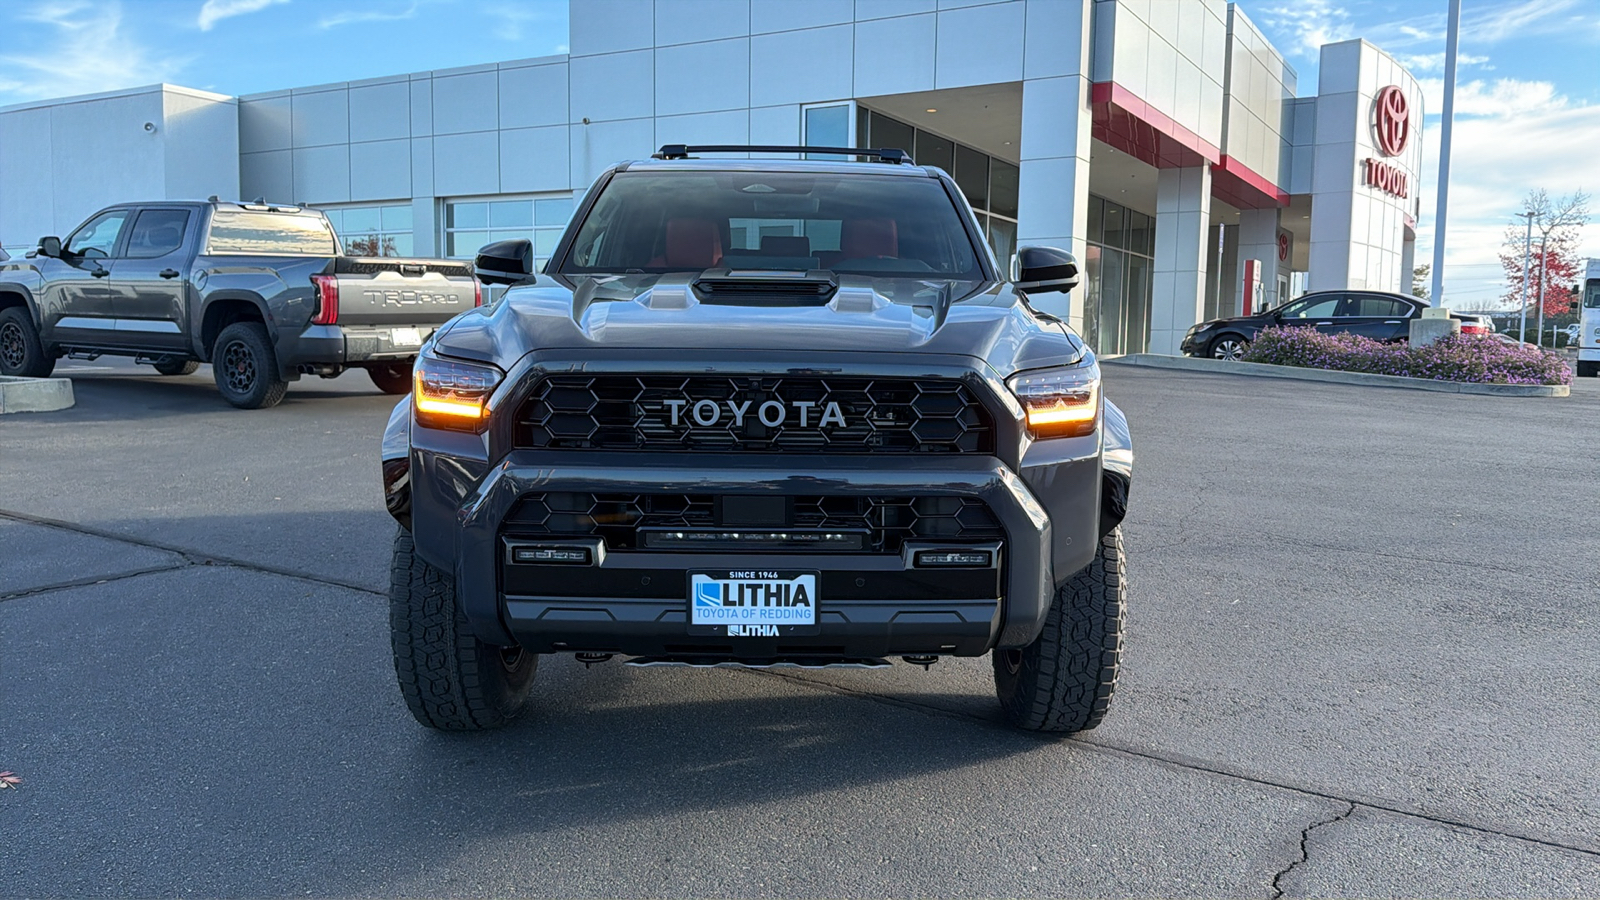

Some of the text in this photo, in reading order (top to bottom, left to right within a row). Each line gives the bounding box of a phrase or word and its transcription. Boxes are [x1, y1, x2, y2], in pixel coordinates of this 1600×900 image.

[1365, 158, 1408, 199] TOYOTA
[663, 399, 847, 428] TOYOTA
[729, 571, 778, 579] SINCE 1946
[722, 583, 811, 607] LITHIA
[696, 608, 811, 619] TOYOTA OF REDDING
[739, 625, 780, 636] LITHIA
